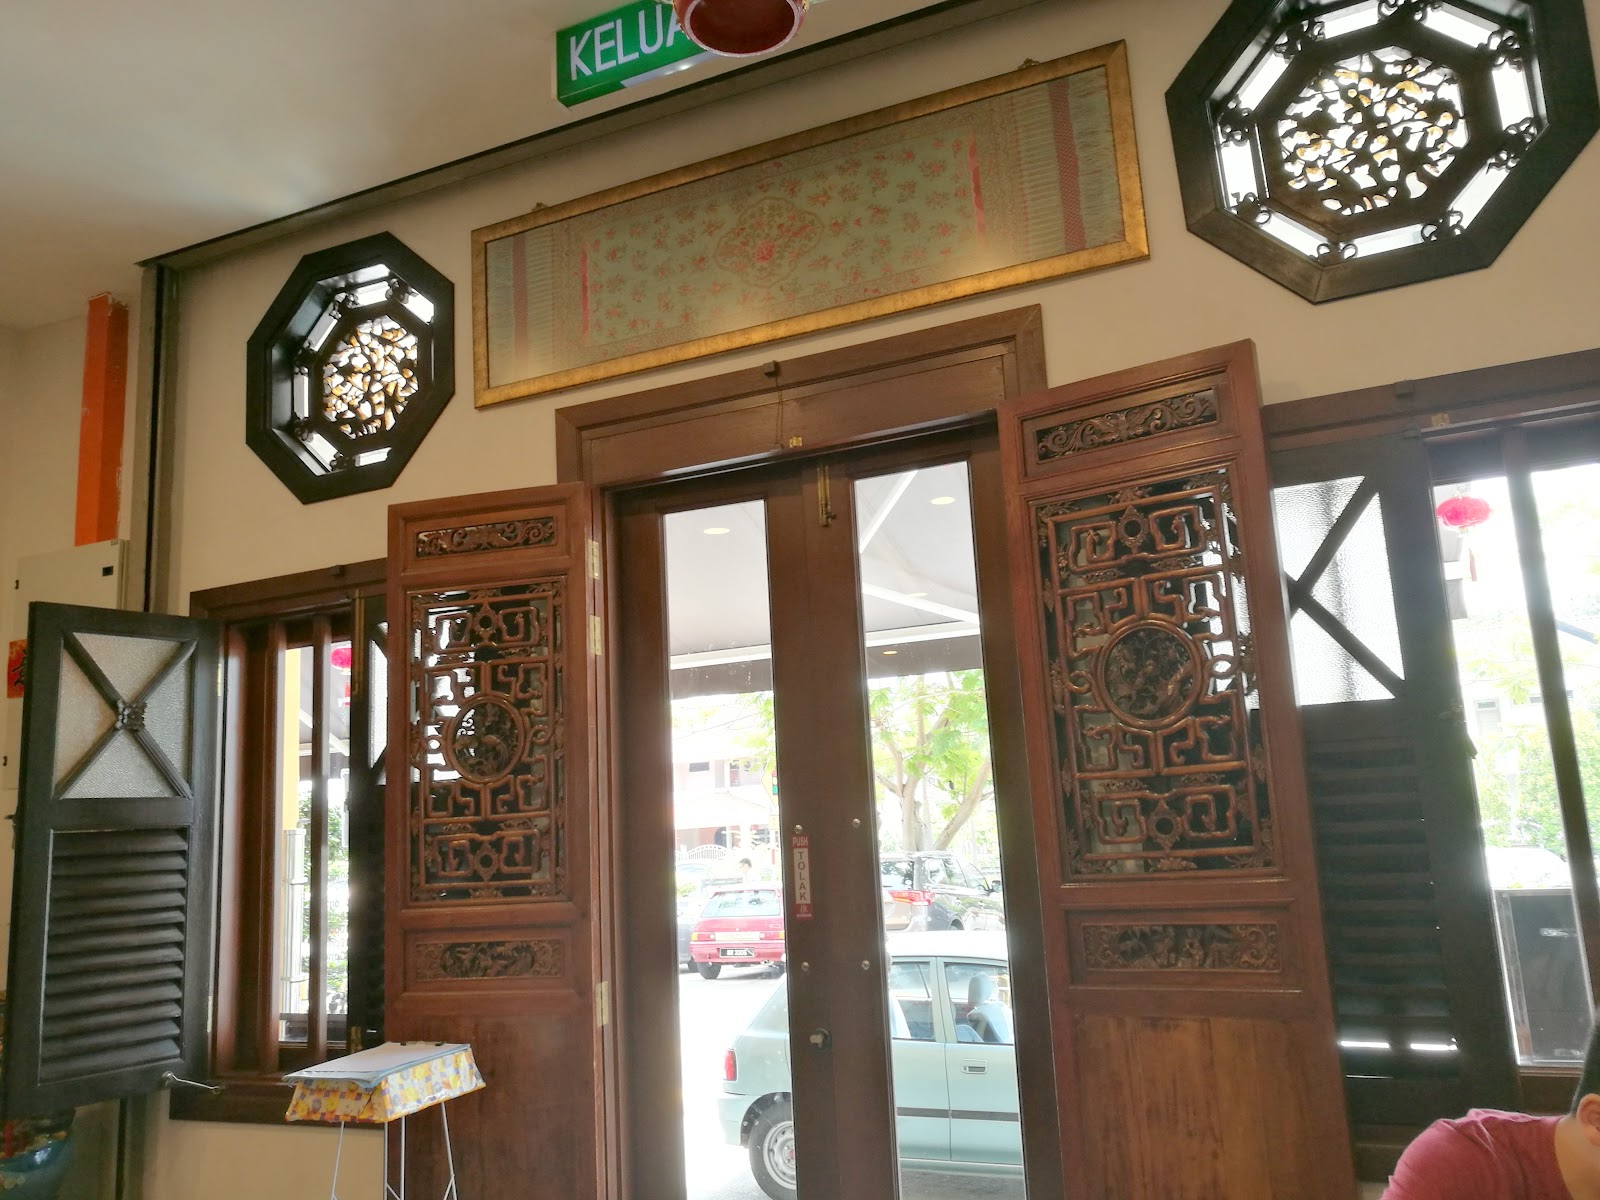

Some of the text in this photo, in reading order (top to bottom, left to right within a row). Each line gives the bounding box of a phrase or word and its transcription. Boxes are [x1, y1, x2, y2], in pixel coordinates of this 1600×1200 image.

[569, 4, 682, 81] KELUA
[792, 836, 808, 847] PUSH
[798, 851, 807, 901] TOLAK
